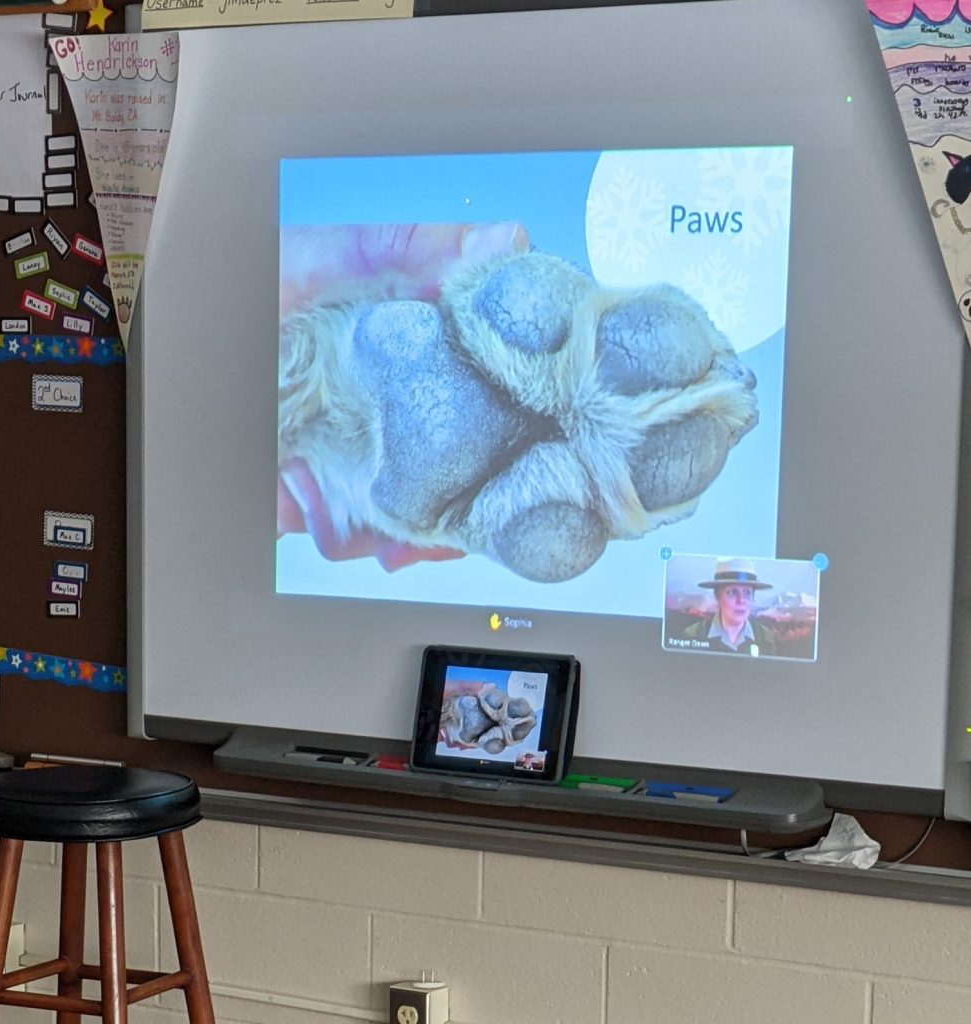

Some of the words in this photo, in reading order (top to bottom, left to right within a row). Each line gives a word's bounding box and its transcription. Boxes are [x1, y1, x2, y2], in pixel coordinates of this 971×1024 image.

[108, 36, 138, 52] Karin
[670, 204, 742, 234] Paws
[66, 318, 83, 330] Lilly
